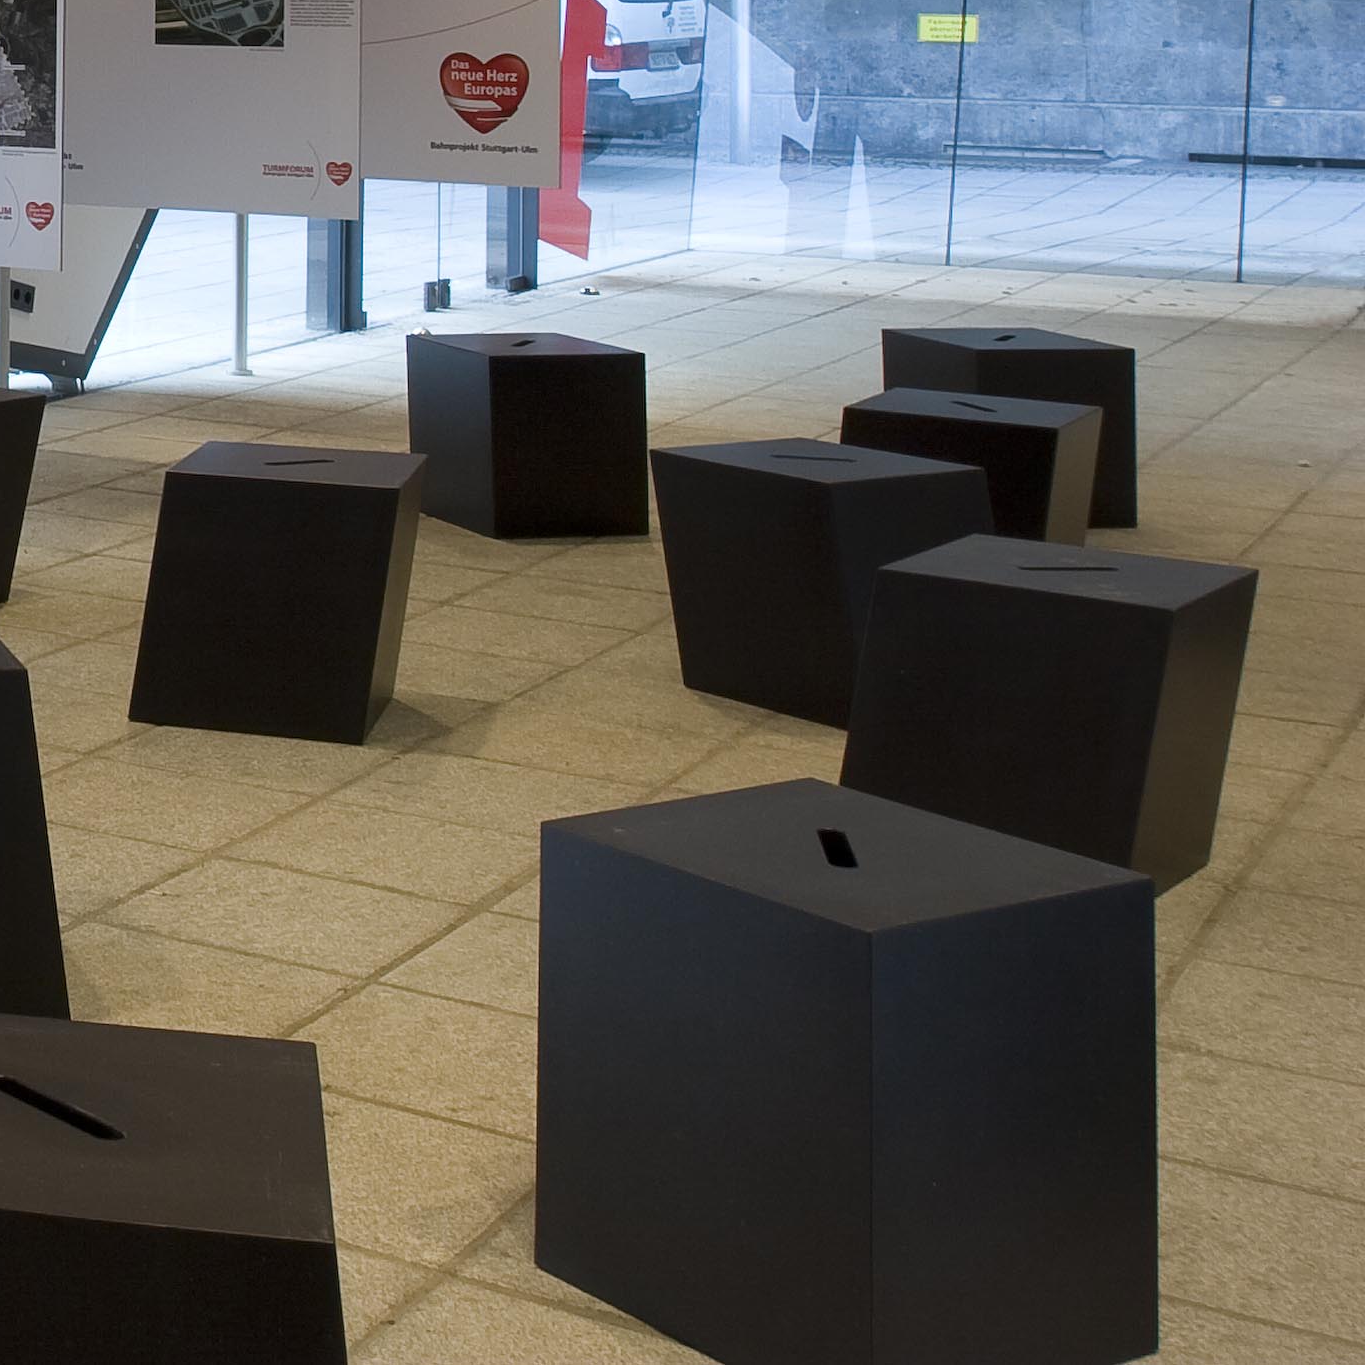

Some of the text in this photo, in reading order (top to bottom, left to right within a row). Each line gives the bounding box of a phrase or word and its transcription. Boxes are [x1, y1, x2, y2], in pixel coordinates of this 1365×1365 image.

[451, 59, 470, 69] Das
[451, 69, 518, 82] neue Herz
[464, 83, 518, 98] Europas
[430, 142, 479, 152] Bahnprojekt
